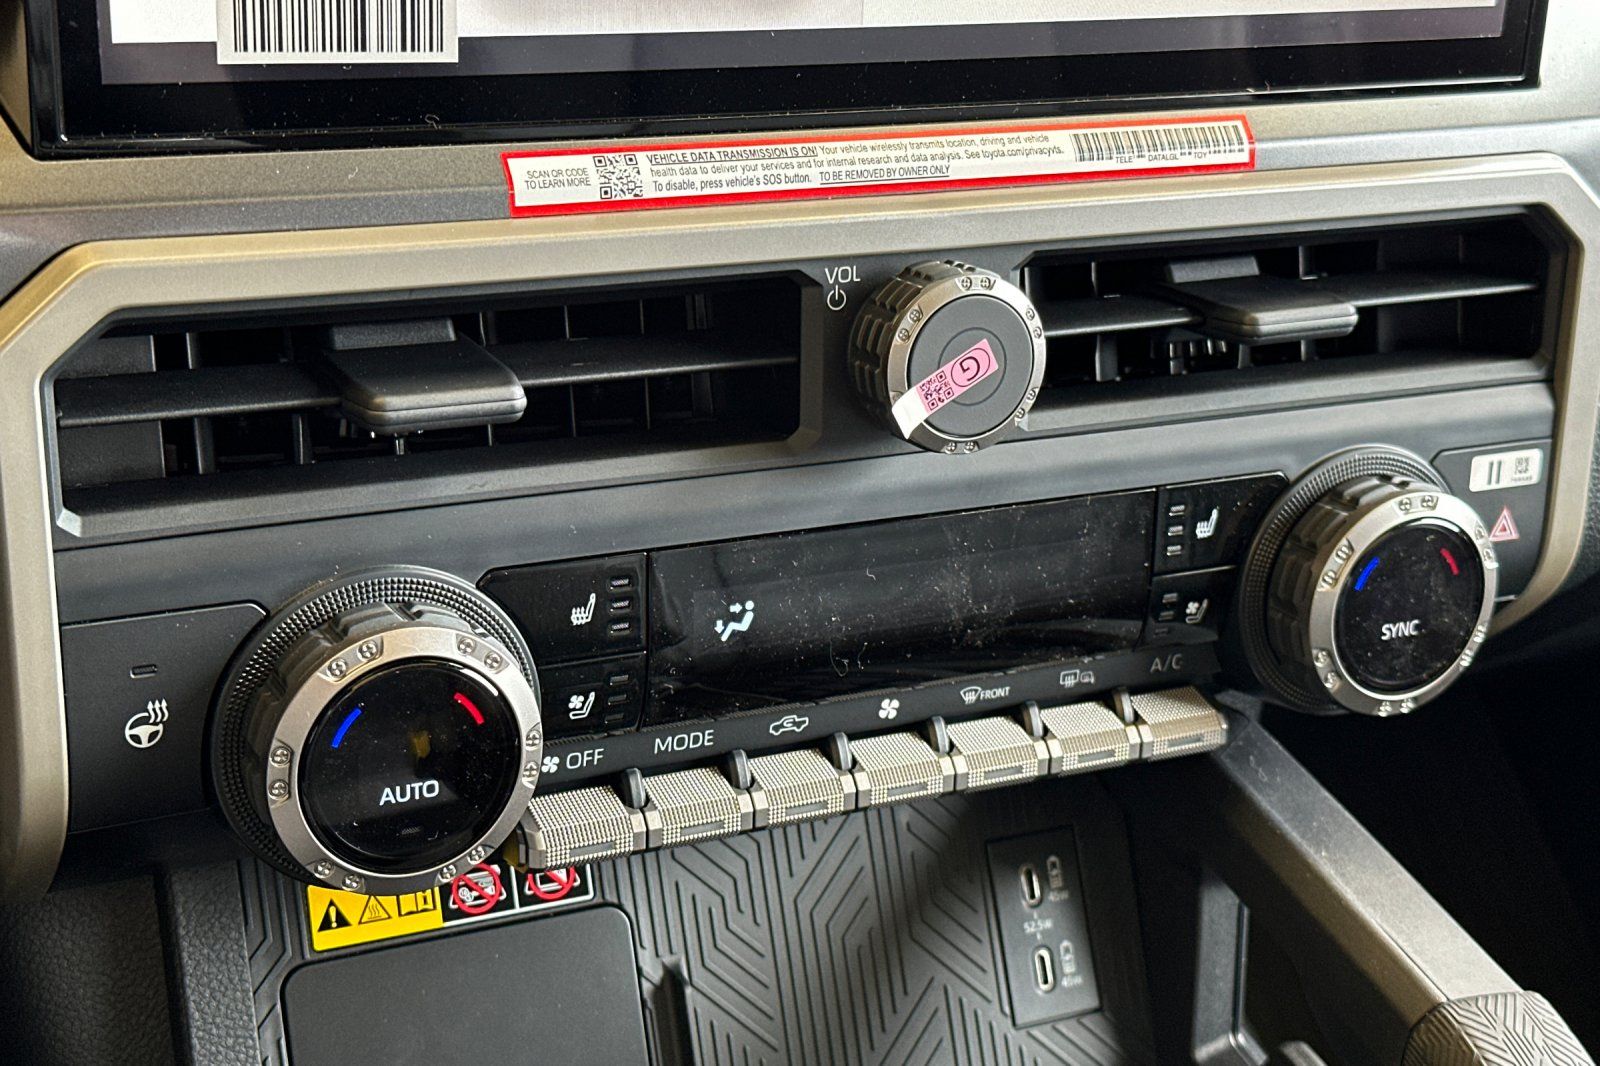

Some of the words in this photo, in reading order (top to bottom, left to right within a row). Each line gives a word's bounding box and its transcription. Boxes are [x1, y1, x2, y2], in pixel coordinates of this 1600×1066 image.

[646, 152, 689, 164] VEHICLE
[690, 150, 717, 162] DATA
[716, 147, 787, 160] TRANSMISSION
[789, 146, 800, 157] IS
[820, 144, 839, 155] Your
[840, 143, 868, 154] vehicle
[870, 140, 908, 152] wirelessly
[908, 138, 945, 150] transmits
[945, 136, 979, 149] location,
[979, 136, 1006, 147] driving
[1007, 135, 1022, 145] and
[1023, 133, 1050, 144] vehicle
[1115, 155, 1133, 164] TELE
[1193, 150, 1208, 159] TOY
[526, 169, 550, 180] SCAN
[551, 168, 565, 178] QR
[565, 167, 589, 178] CODE
[650, 166, 678, 178] health
[679, 165, 699, 176] data
[699, 164, 710, 175] to
[711, 163, 739, 174] deliver
[740, 163, 759, 175] your
[760, 160, 795, 171] services
[796, 160, 813, 170] and
[813, 159, 825, 169] for
[826, 156, 857, 168] internal
[857, 155, 894, 167] research
[894, 154, 910, 164] and
[911, 153, 929, 163] data
[929, 150, 964, 164] analysis.
[964, 149, 982, 160] See
[524, 180, 537, 191] TO
[538, 178, 566, 190] LEARN
[567, 177, 592, 188] MORE
[653, 180, 664, 193] To
[665, 178, 699, 192] disable,
[700, 179, 724, 191] press
[725, 175, 761, 188] vehicle's
[762, 173, 783, 186] SOS
[784, 169, 813, 184] button.
[819, 171, 832, 182] TO
[832, 170, 844, 181] BE
[845, 168, 886, 181] REMOVED
[886, 167, 899, 178] BY
[898, 165, 929, 177] OWNER
[929, 164, 951, 175] ONLY
[825, 265, 861, 284] VOL
[1381, 619, 1419, 641] SYNC
[1150, 653, 1183, 673] A/C
[979, 686, 1011, 701] FRONT
[653, 729, 715, 755] MODE
[566, 748, 605, 770] OFF
[379, 779, 440, 806] AUTO
